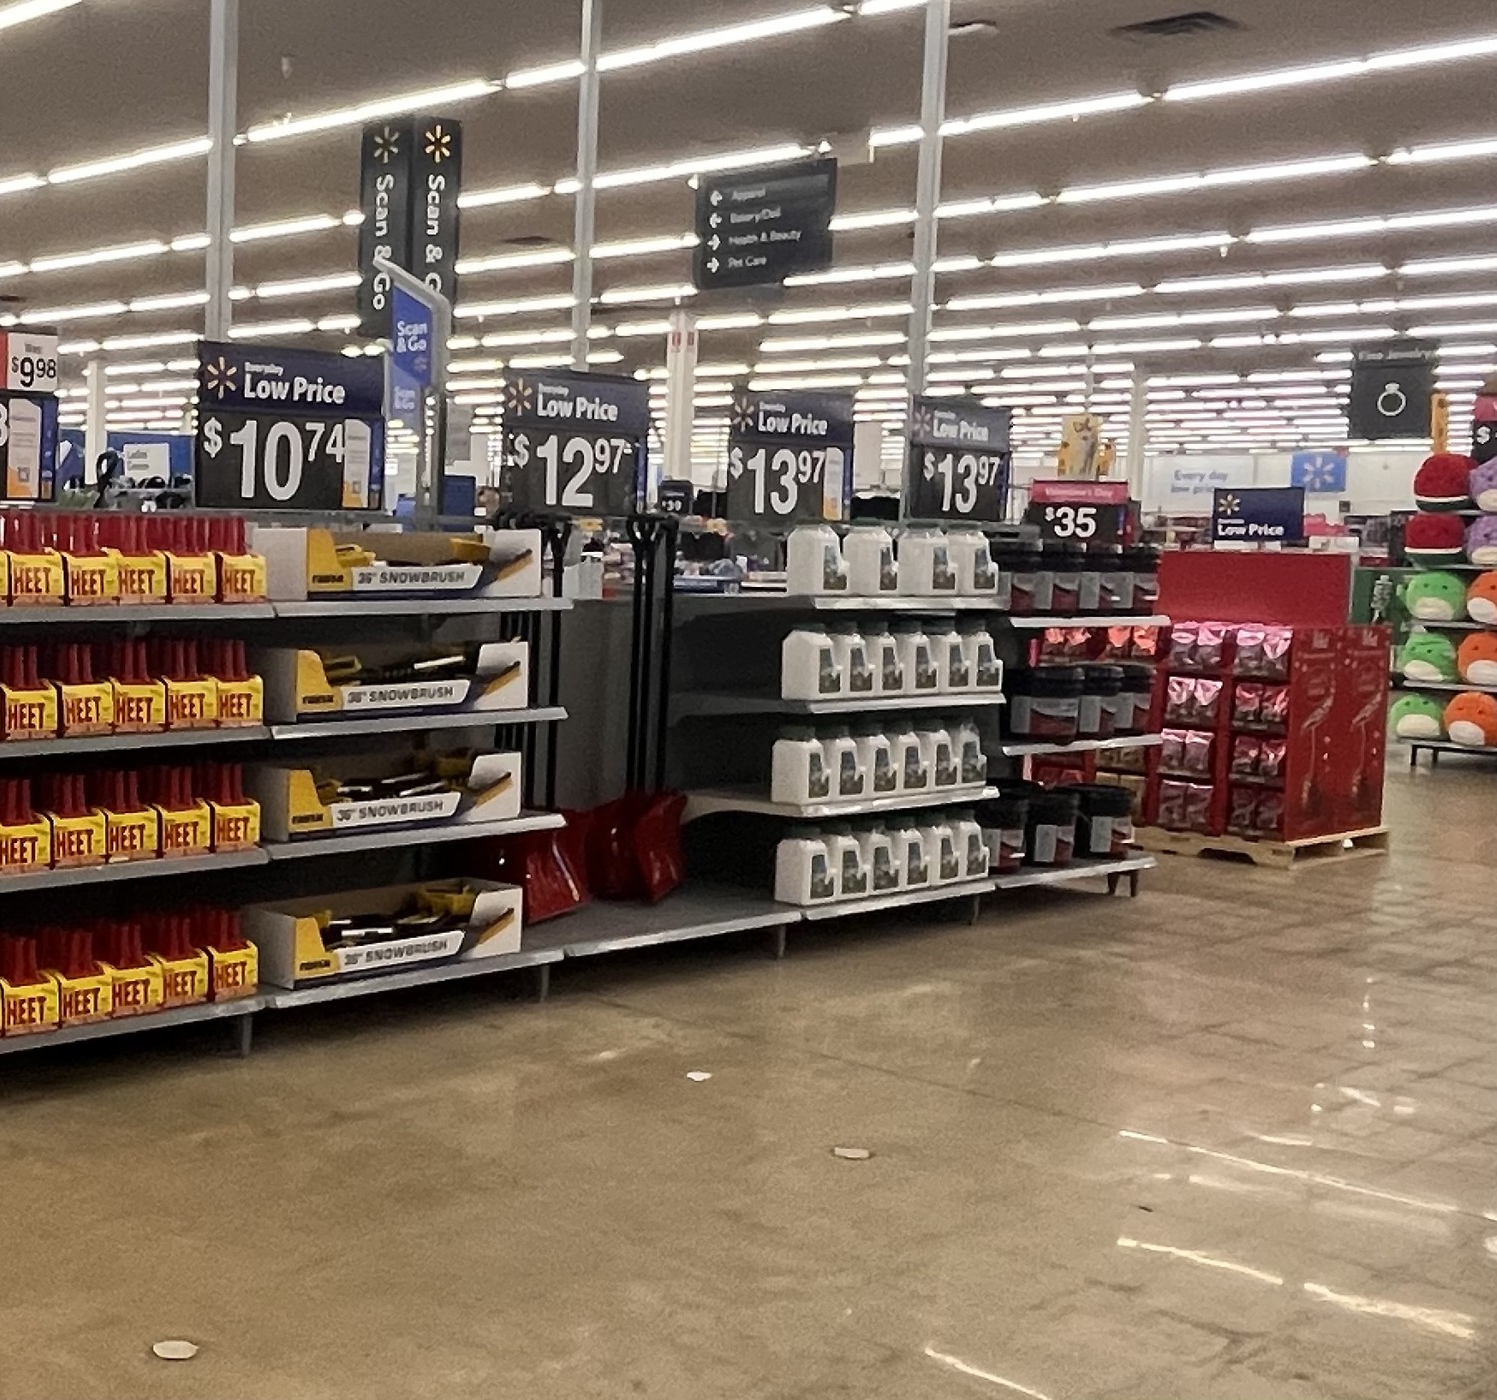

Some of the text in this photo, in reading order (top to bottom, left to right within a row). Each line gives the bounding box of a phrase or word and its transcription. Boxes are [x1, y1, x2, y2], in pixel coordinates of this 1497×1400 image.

[375, 174, 395, 237] Scan
[425, 174, 446, 293] Scan & G
[372, 272, 391, 310] Go
[397, 320, 428, 336] Scan
[244, 373, 346, 404] Low Price
[537, 393, 618, 421] Low Price
[758, 410, 828, 435] Low Price
[933, 418, 989, 441] Low Price
[1174, 470, 1229, 482] Every day
[1044, 506, 1097, 538] $35
[1217, 523, 1285, 536] Low Price
[13, 567, 51, 594] HEET
[71, 568, 106, 596] HEET
[118, 569, 155, 596] HEET
[172, 569, 204, 594] HEET
[222, 568, 255, 594] HEET
[380, 571, 465, 584] SNOWBRUSH
[168, 693, 205, 720] HEET
[219, 693, 252, 718] HEET
[369, 687, 453, 703] SNOWBRUSH
[7, 702, 45, 731] HEET
[65, 696, 102, 724] HEET
[115, 697, 153, 724] HEET
[358, 801, 443, 819] SNOWBRUSH
[56, 829, 93, 857] HEET
[109, 824, 146, 851] HEET
[164, 821, 199, 847] HEET
[215, 816, 250, 843] HEET
[1, 836, 39, 864] HEET
[366, 940, 447, 963] SNOWBRUSH
[162, 971, 198, 1000] HEET
[214, 961, 248, 988] HEET
[62, 988, 101, 1016] HEET
[112, 979, 150, 1007] HEET
[5, 996, 47, 1024] HEET
